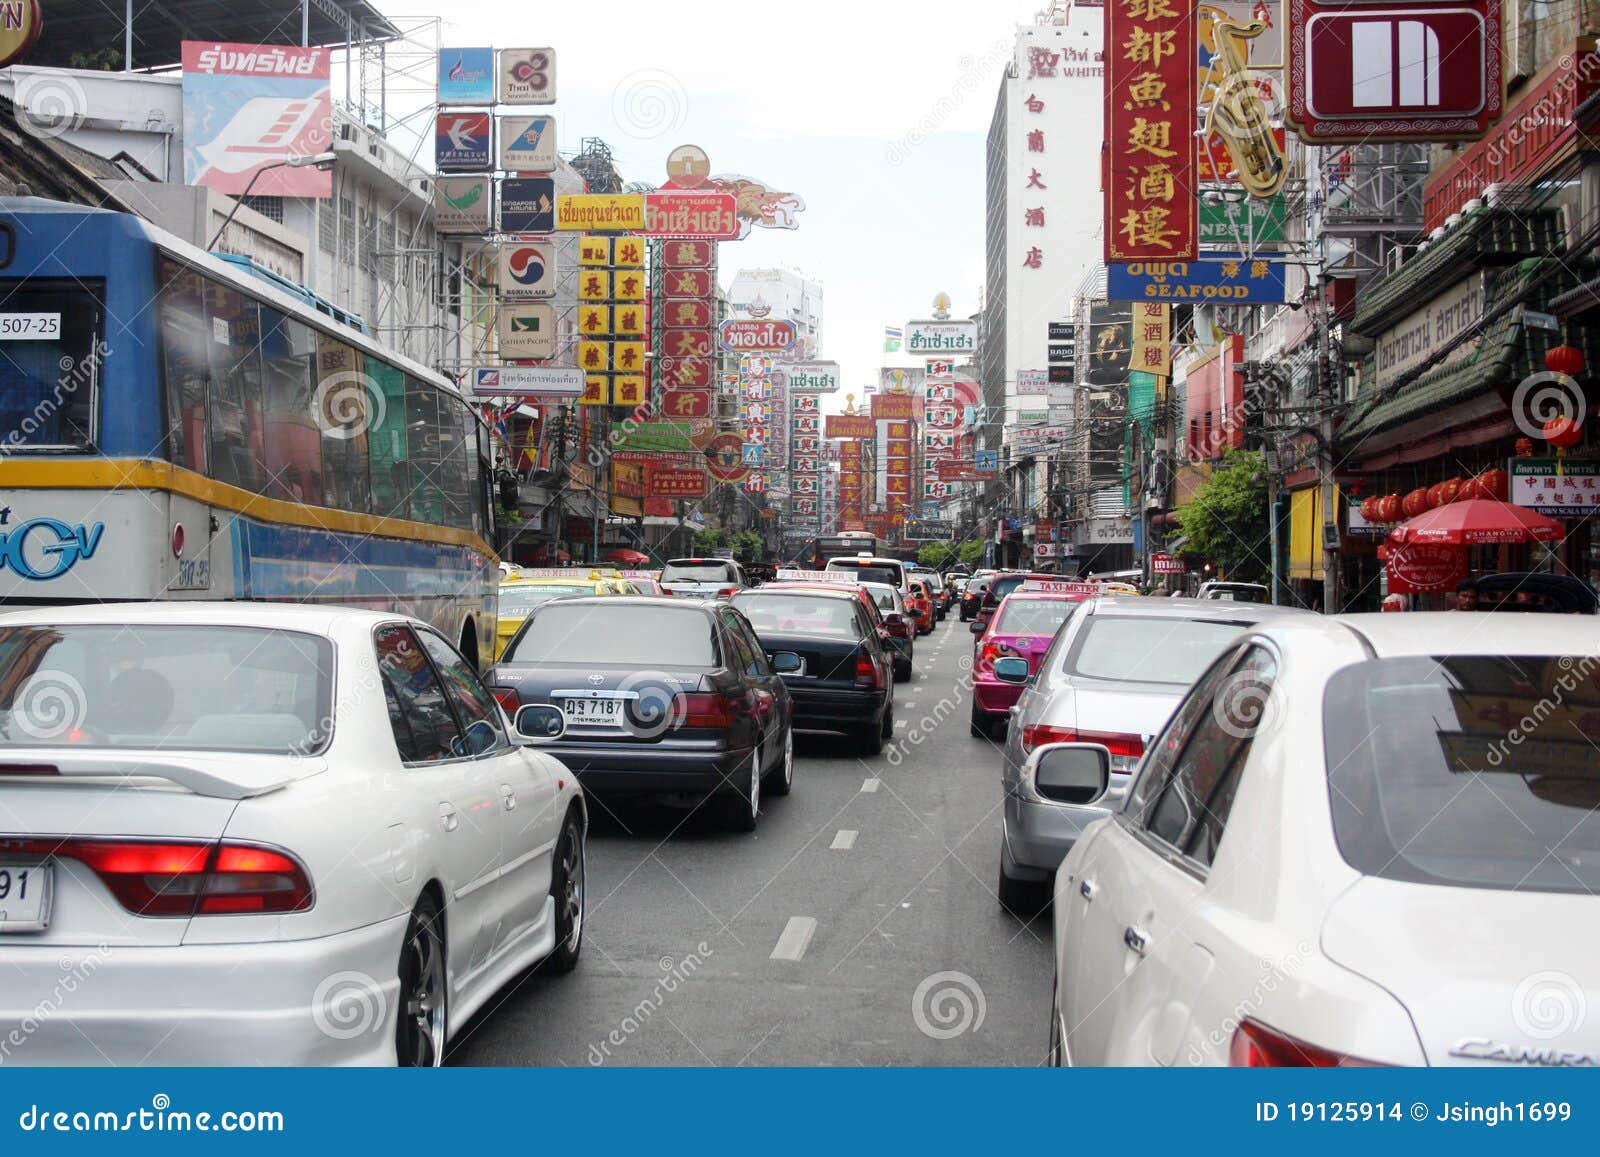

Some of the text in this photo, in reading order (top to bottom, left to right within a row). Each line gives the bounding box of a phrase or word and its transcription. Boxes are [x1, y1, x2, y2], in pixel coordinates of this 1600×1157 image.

[1024, 93, 1048, 270] 白蘭大酒店
[1145, 284, 1249, 298] SEAFOOD
[2, 318, 57, 333] 507-25
[590, 700, 622, 714] 7187
